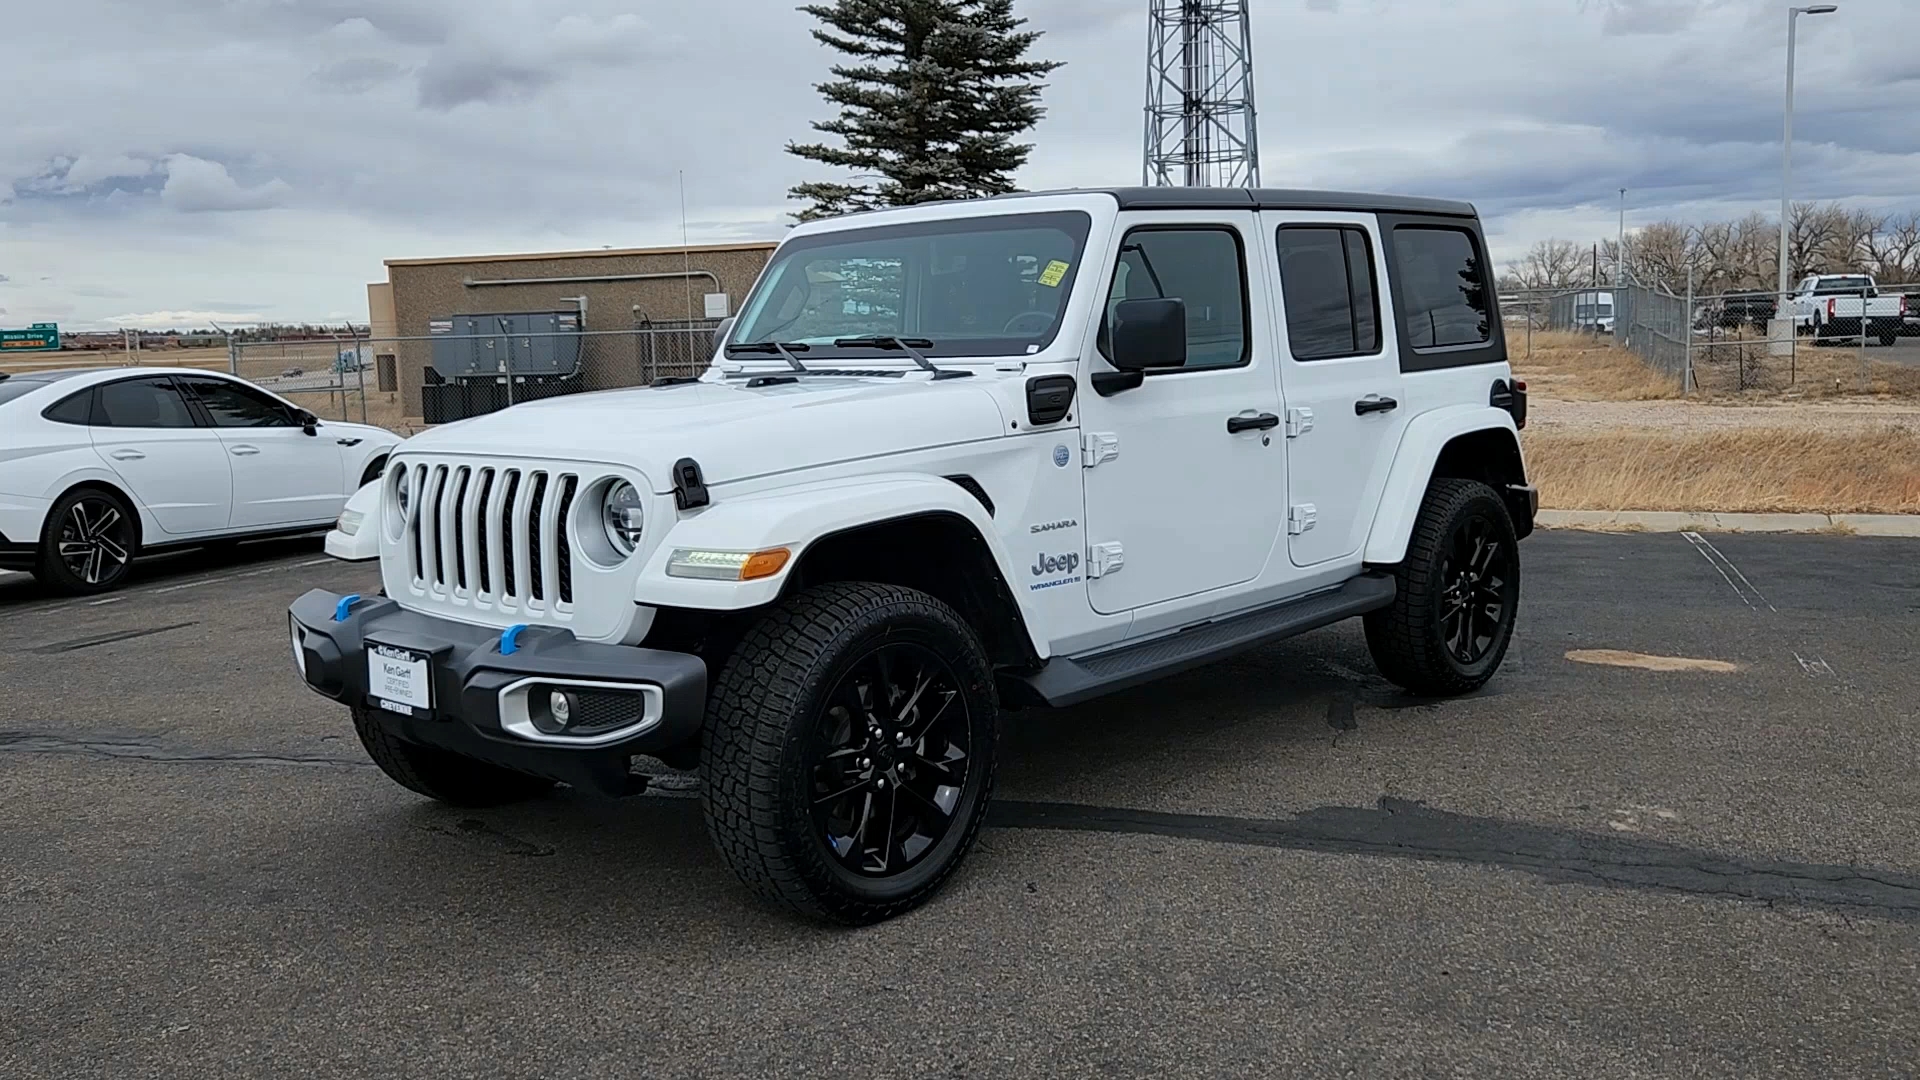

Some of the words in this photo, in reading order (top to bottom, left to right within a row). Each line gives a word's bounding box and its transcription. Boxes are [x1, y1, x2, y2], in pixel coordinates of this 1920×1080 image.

[1030, 519, 1078, 534] SAHARA
[1031, 551, 1080, 576] Jeep
[1030, 577, 1073, 591] WRANGLER
[383, 662, 395, 675] Ken
